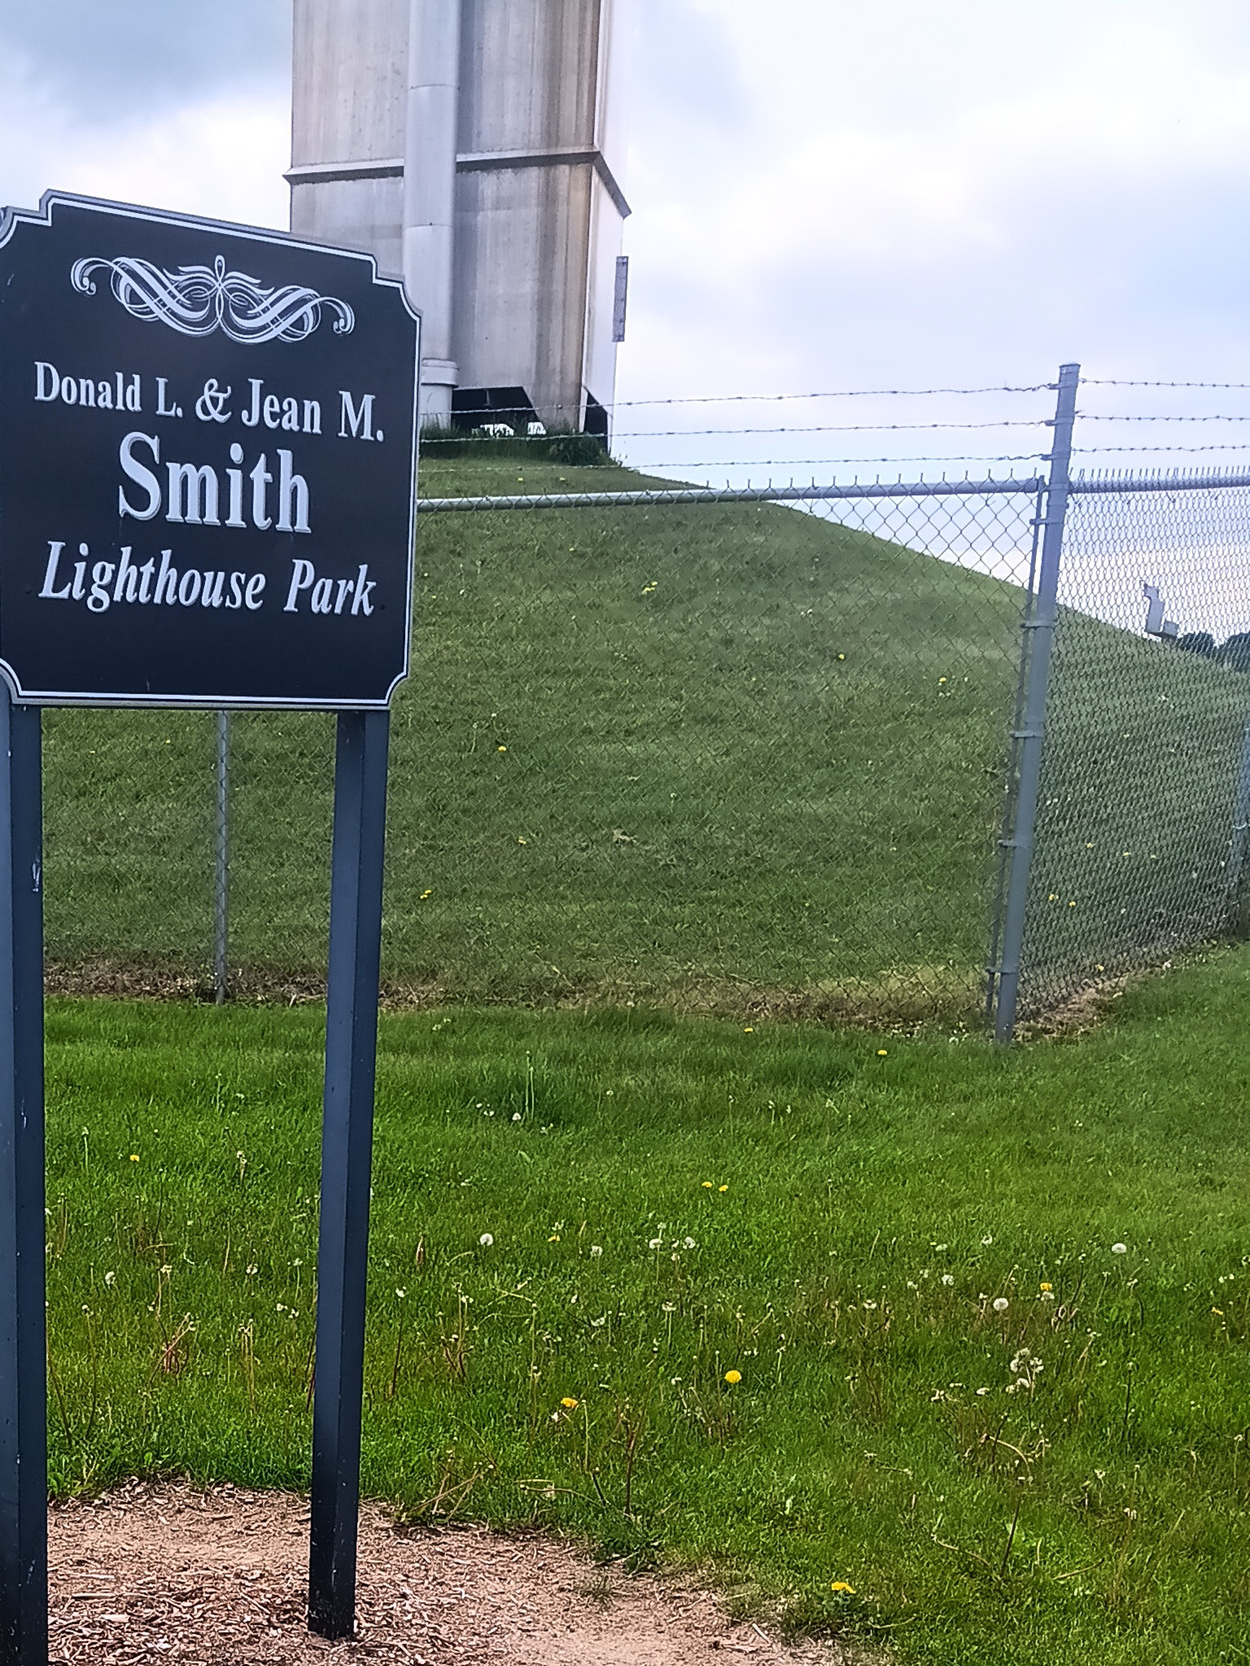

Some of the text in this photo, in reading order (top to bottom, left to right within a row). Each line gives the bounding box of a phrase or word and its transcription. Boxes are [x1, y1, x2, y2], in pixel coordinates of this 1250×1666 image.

[33, 361, 385, 443] Donald L. & Jean M.
[118, 430, 313, 534] Smith
[37, 540, 377, 617] Lighthouse Park
